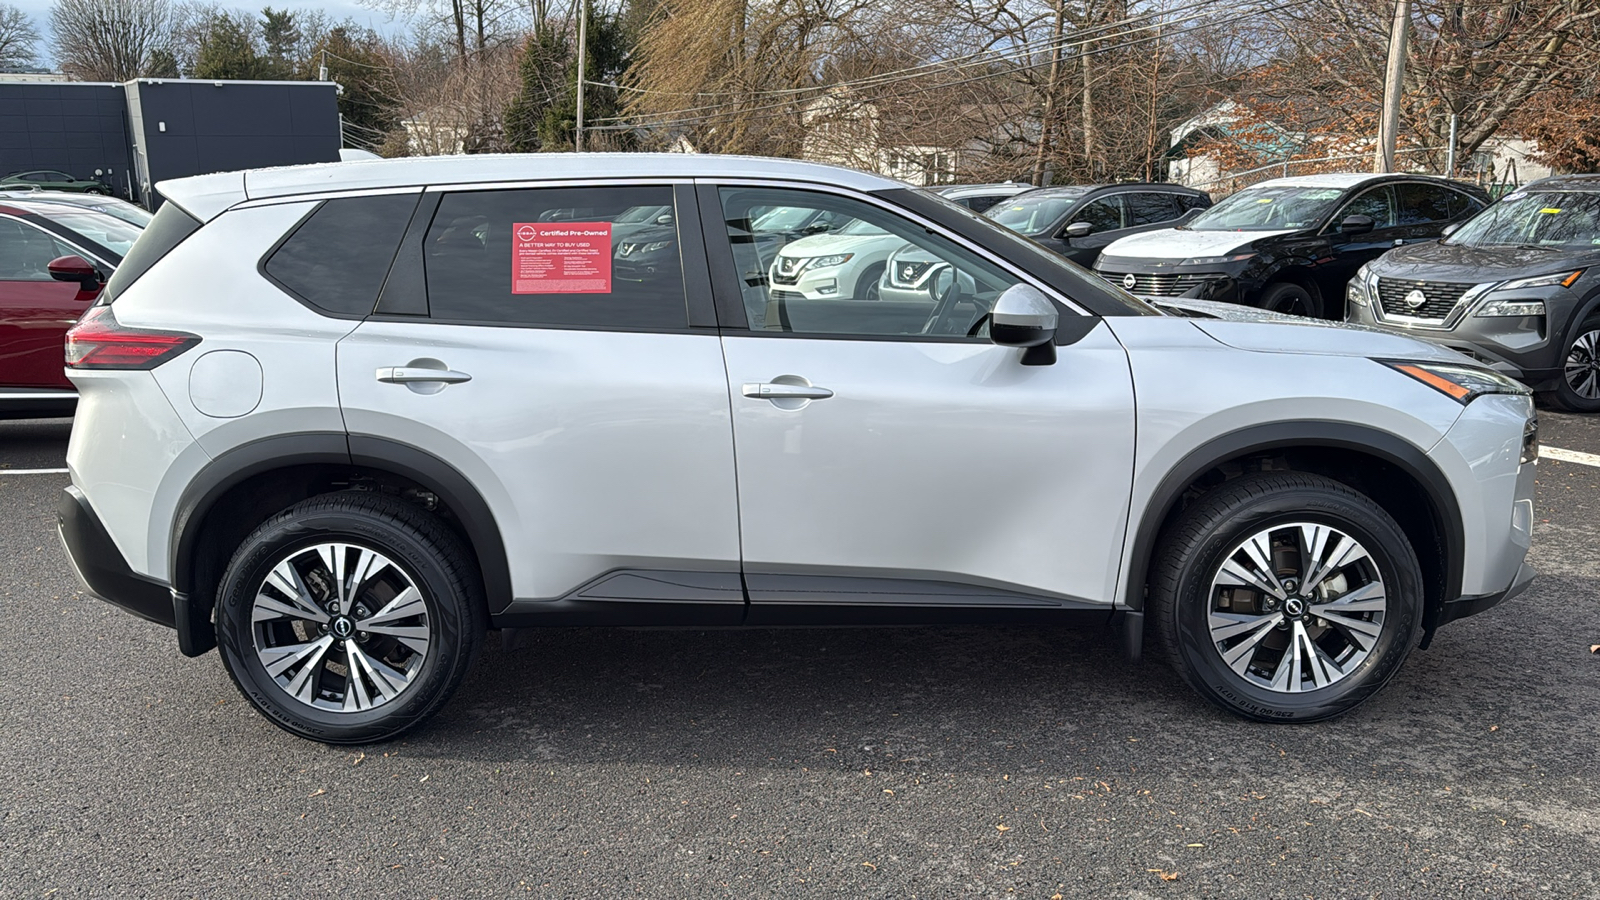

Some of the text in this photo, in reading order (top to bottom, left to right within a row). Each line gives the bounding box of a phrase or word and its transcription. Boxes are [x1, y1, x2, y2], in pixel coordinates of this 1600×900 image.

[250, 691, 271, 710] 107V
[1259, 707, 1295, 718] 235/60
[291, 721, 325, 735] 235/60
